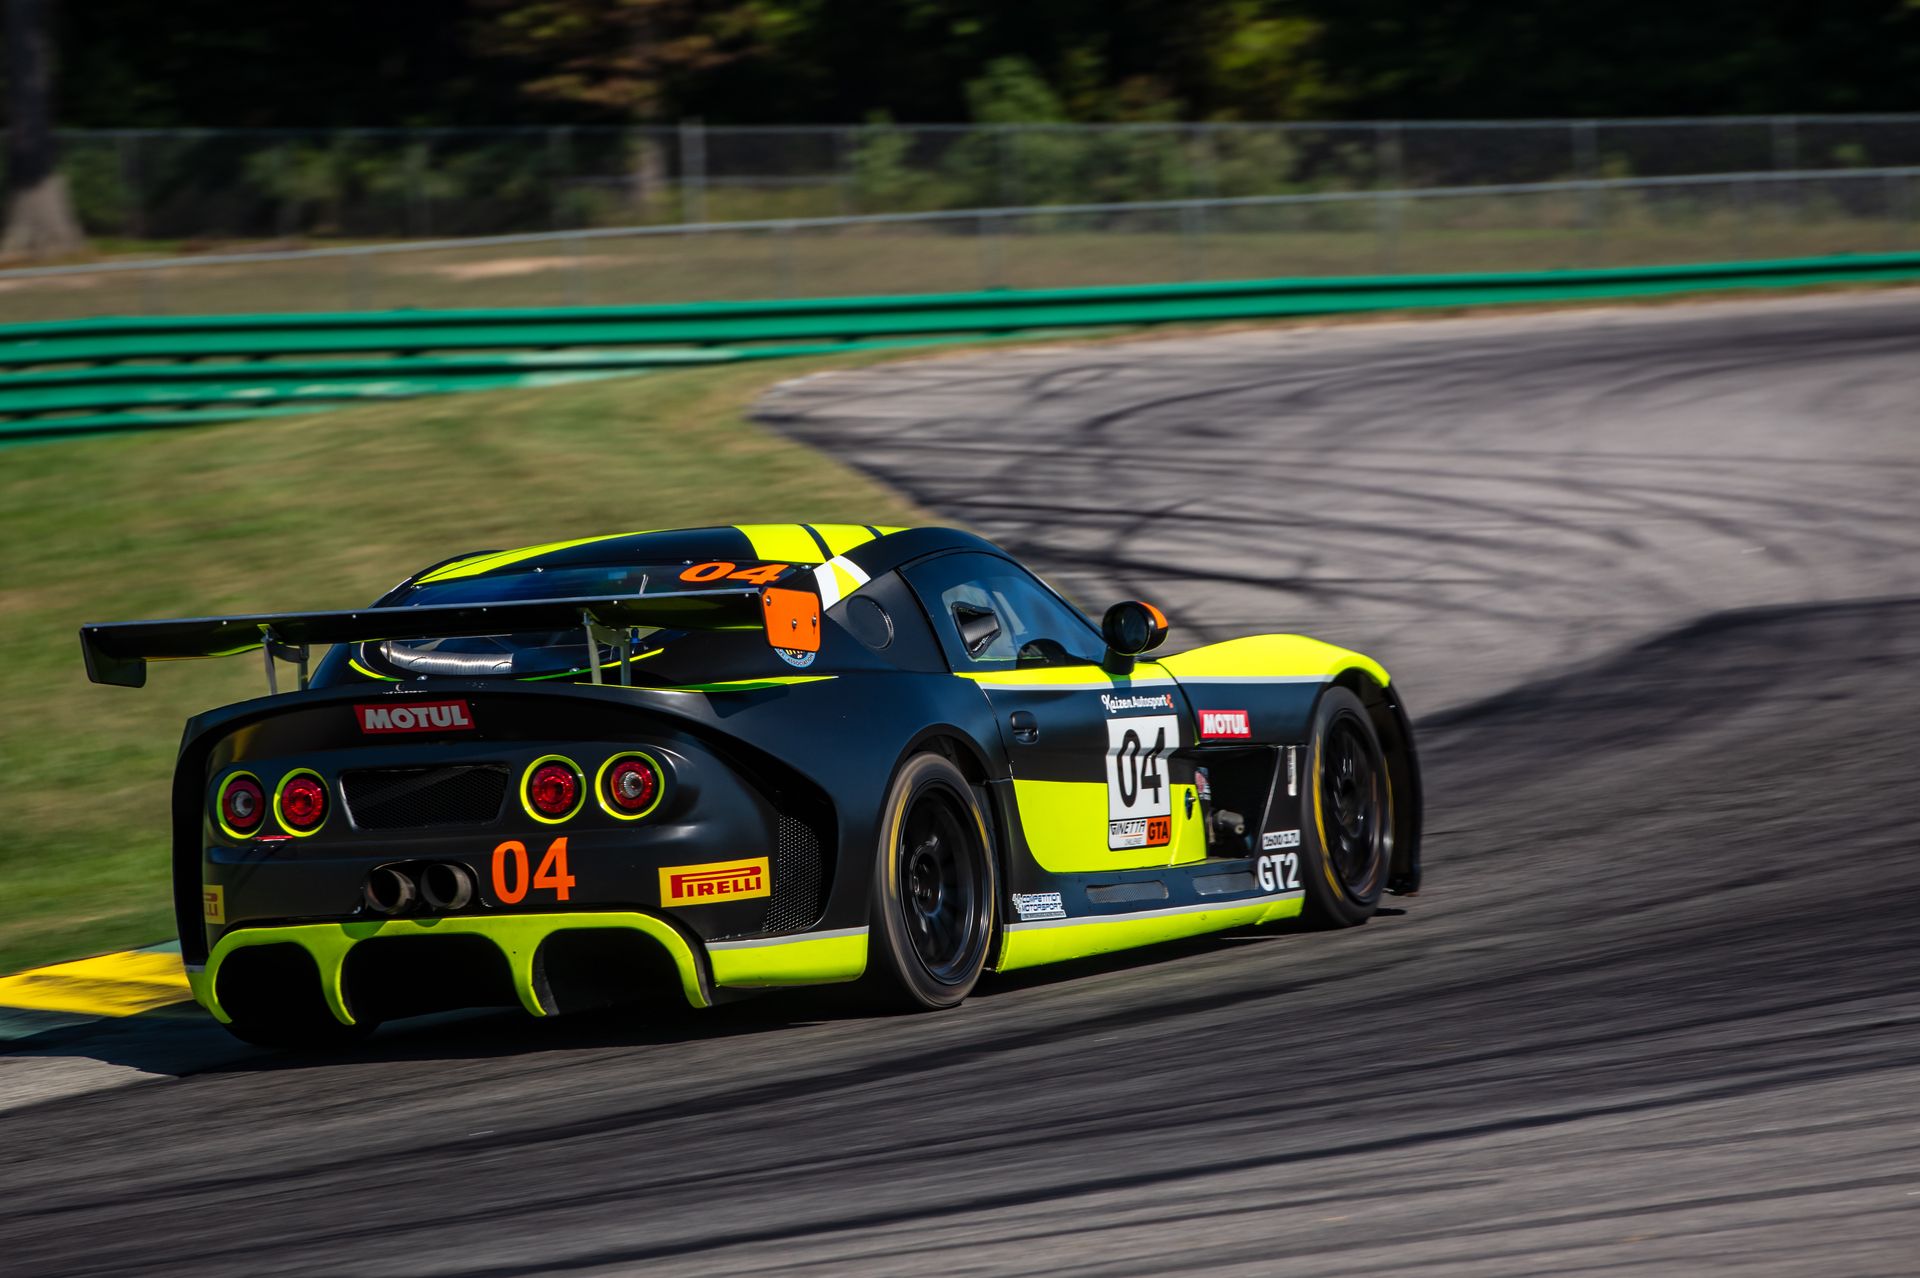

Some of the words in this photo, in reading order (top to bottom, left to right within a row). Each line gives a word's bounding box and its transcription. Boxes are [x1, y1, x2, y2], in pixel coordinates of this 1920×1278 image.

[679, 562, 789, 585] 04
[1101, 694, 1132, 713] Kaizen
[1131, 694, 1168, 709] Autosport
[365, 705, 469, 729] MOTUL
[1203, 714, 1248, 734] MOTUL
[1116, 726, 1166, 808] 04
[1110, 820, 1146, 835] GINETTA
[1147, 821, 1169, 840] GTA
[491, 836, 576, 904] 04
[1257, 852, 1300, 891] GT2
[670, 866, 762, 899] PIRELLI
[1021, 902, 1062, 912] MOTORSPORT
[1022, 893, 1061, 904] COMPETITION
